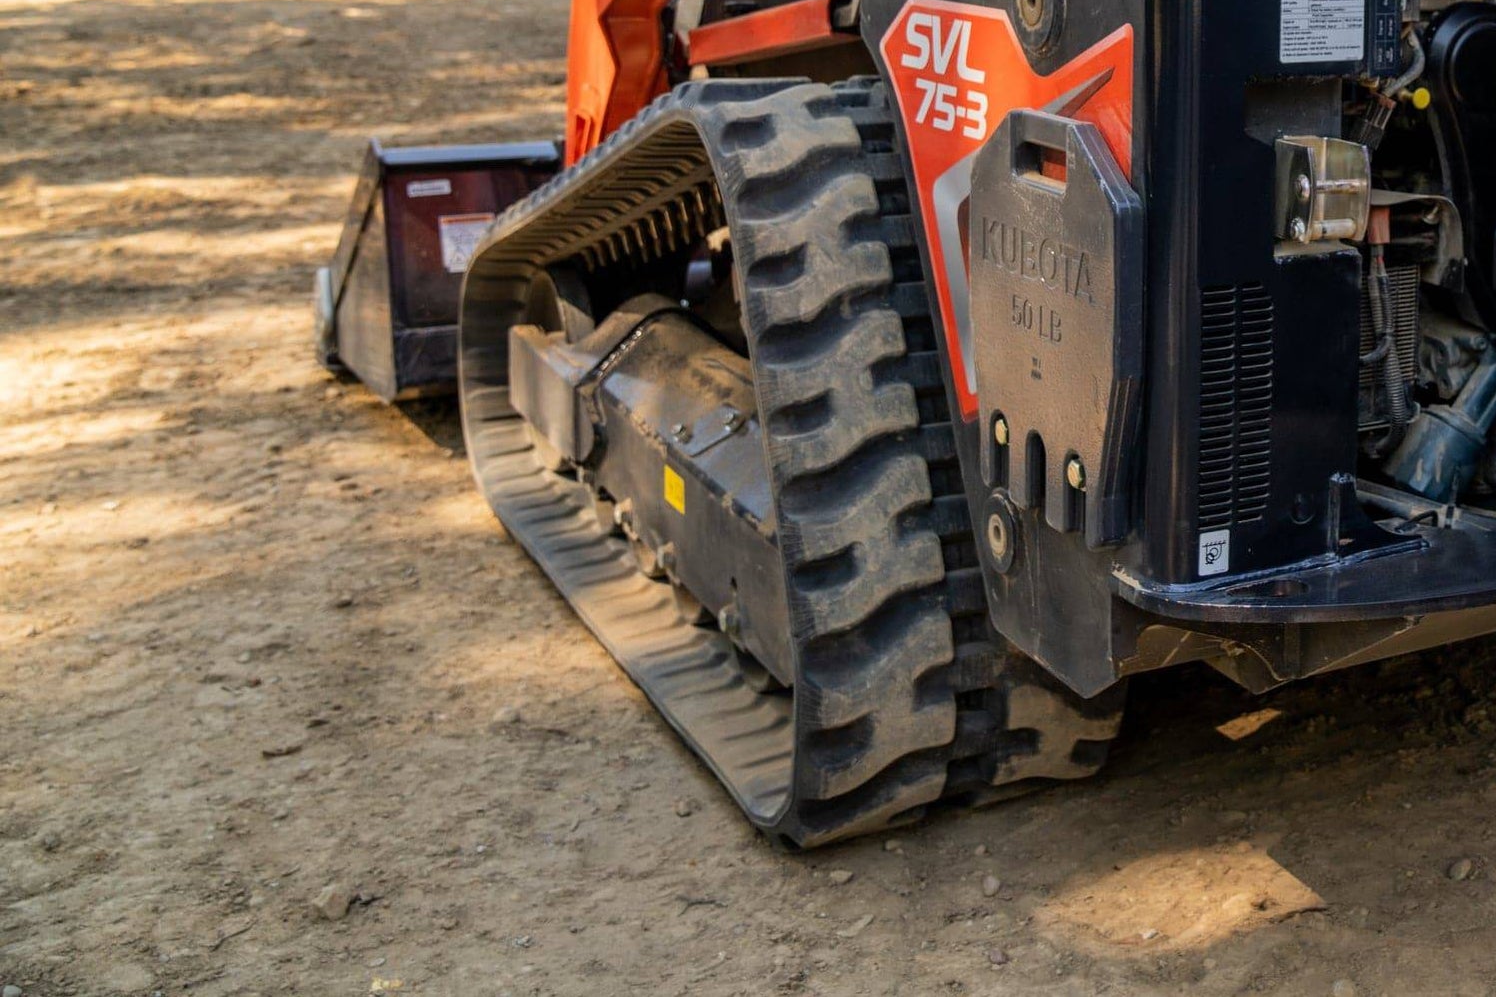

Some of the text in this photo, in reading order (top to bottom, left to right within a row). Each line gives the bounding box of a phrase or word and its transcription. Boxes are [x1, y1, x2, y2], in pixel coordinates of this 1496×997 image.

[901, 12, 985, 84] SVL
[915, 77, 988, 141] 75-3
[981, 215, 1096, 306] KUBOTA
[1011, 294, 1063, 344] 50 LB
